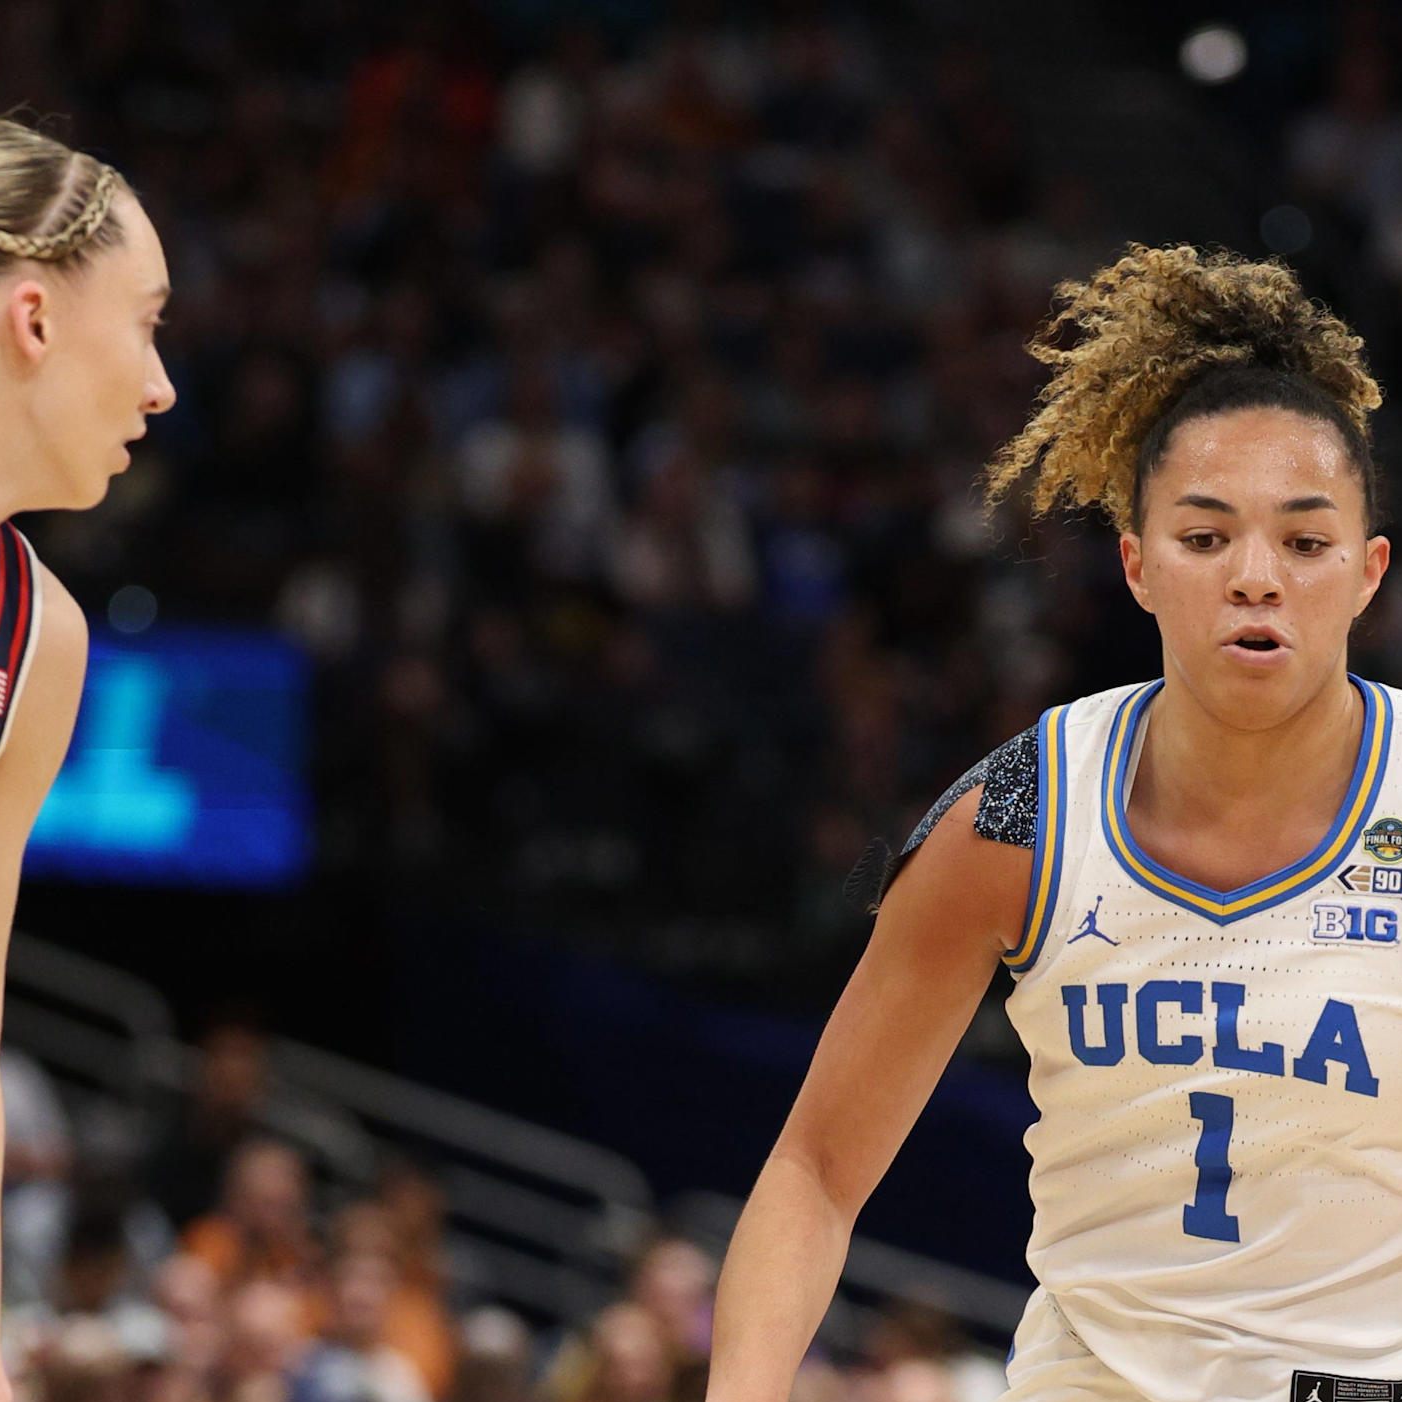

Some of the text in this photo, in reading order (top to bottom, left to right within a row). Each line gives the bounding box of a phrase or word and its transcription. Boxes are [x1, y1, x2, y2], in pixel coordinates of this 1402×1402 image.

[1366, 834, 1389, 846] FINAL
[1374, 870, 1401, 891] 90
[1061, 980, 1379, 1098] UCLA
[1182, 1091, 1241, 1243] 1
